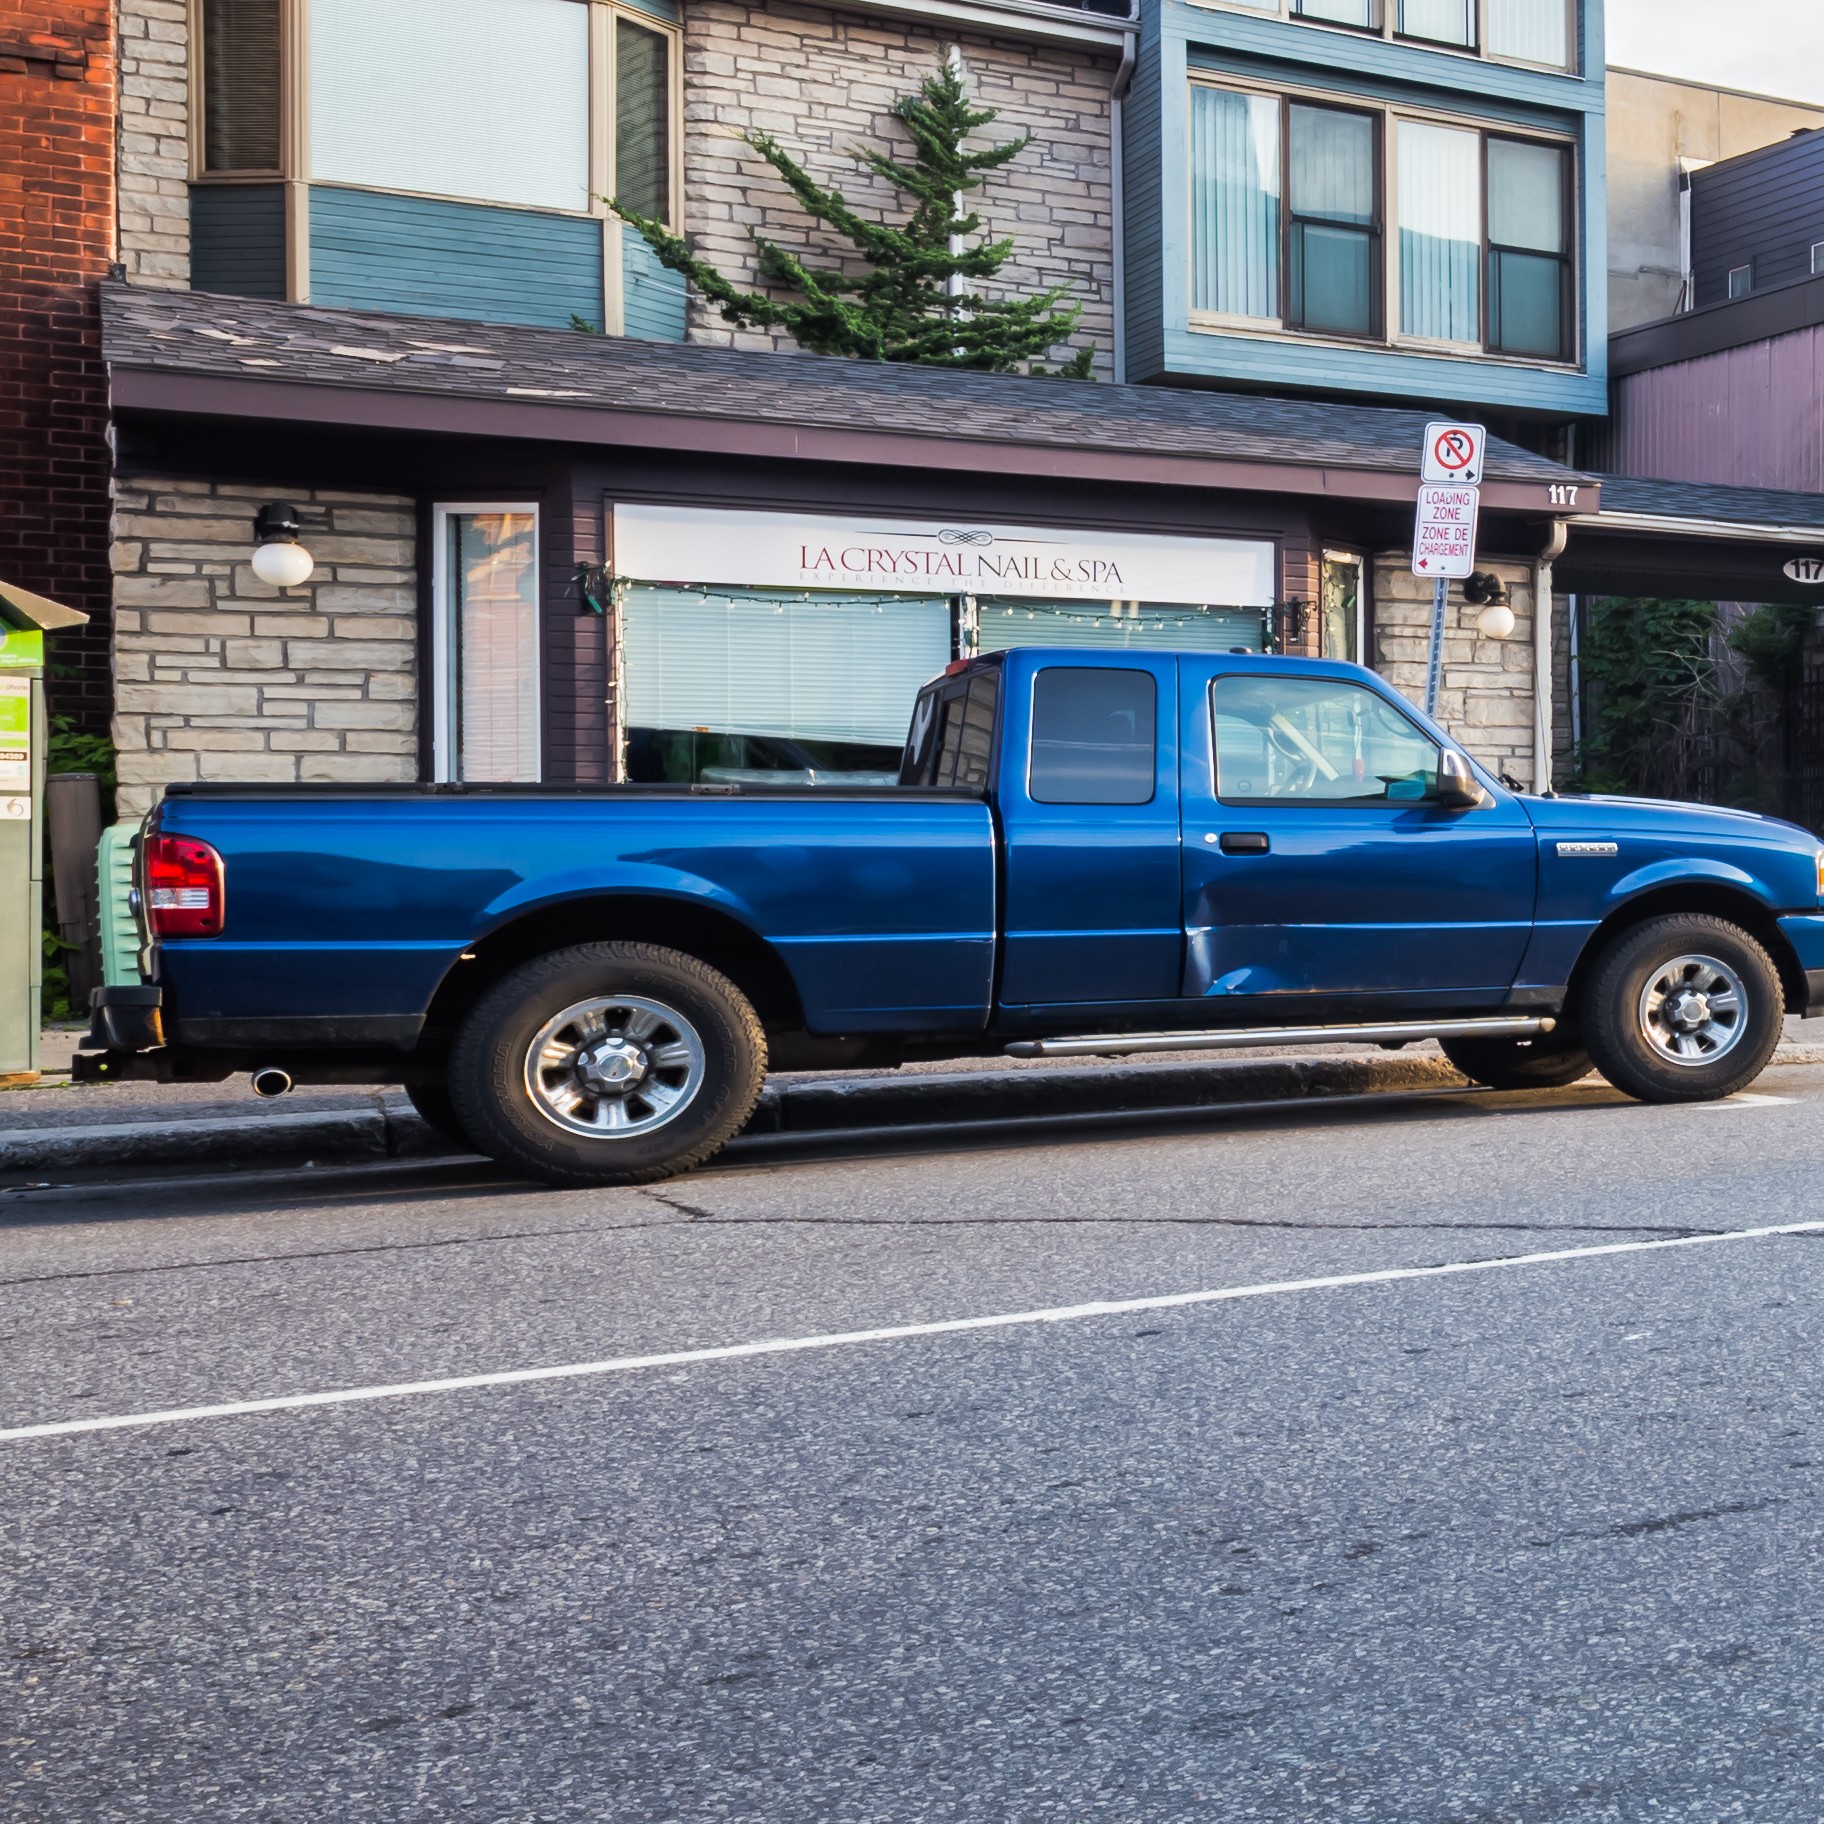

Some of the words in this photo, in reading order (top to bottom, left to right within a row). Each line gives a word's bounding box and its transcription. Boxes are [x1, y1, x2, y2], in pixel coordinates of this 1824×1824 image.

[1426, 491, 1470, 506] LOADING
[1548, 484, 1579, 506] 117
[1433, 506, 1461, 520] ZONE
[1422, 526, 1450, 541] ZONE
[1454, 528, 1468, 541] DE
[1419, 542, 1469, 557] CHARGEMENT
[800, 545, 836, 571] LA
[841, 547, 972, 577] CRYSTAL
[977, 554, 1048, 581] NAIL
[1050, 558, 1072, 582] &
[1077, 559, 1124, 584] SPA
[799, 571, 934, 586] EXPERIENCE
[950, 577, 987, 589] THE
[1003, 580, 1127, 595] DIFFERENCE
